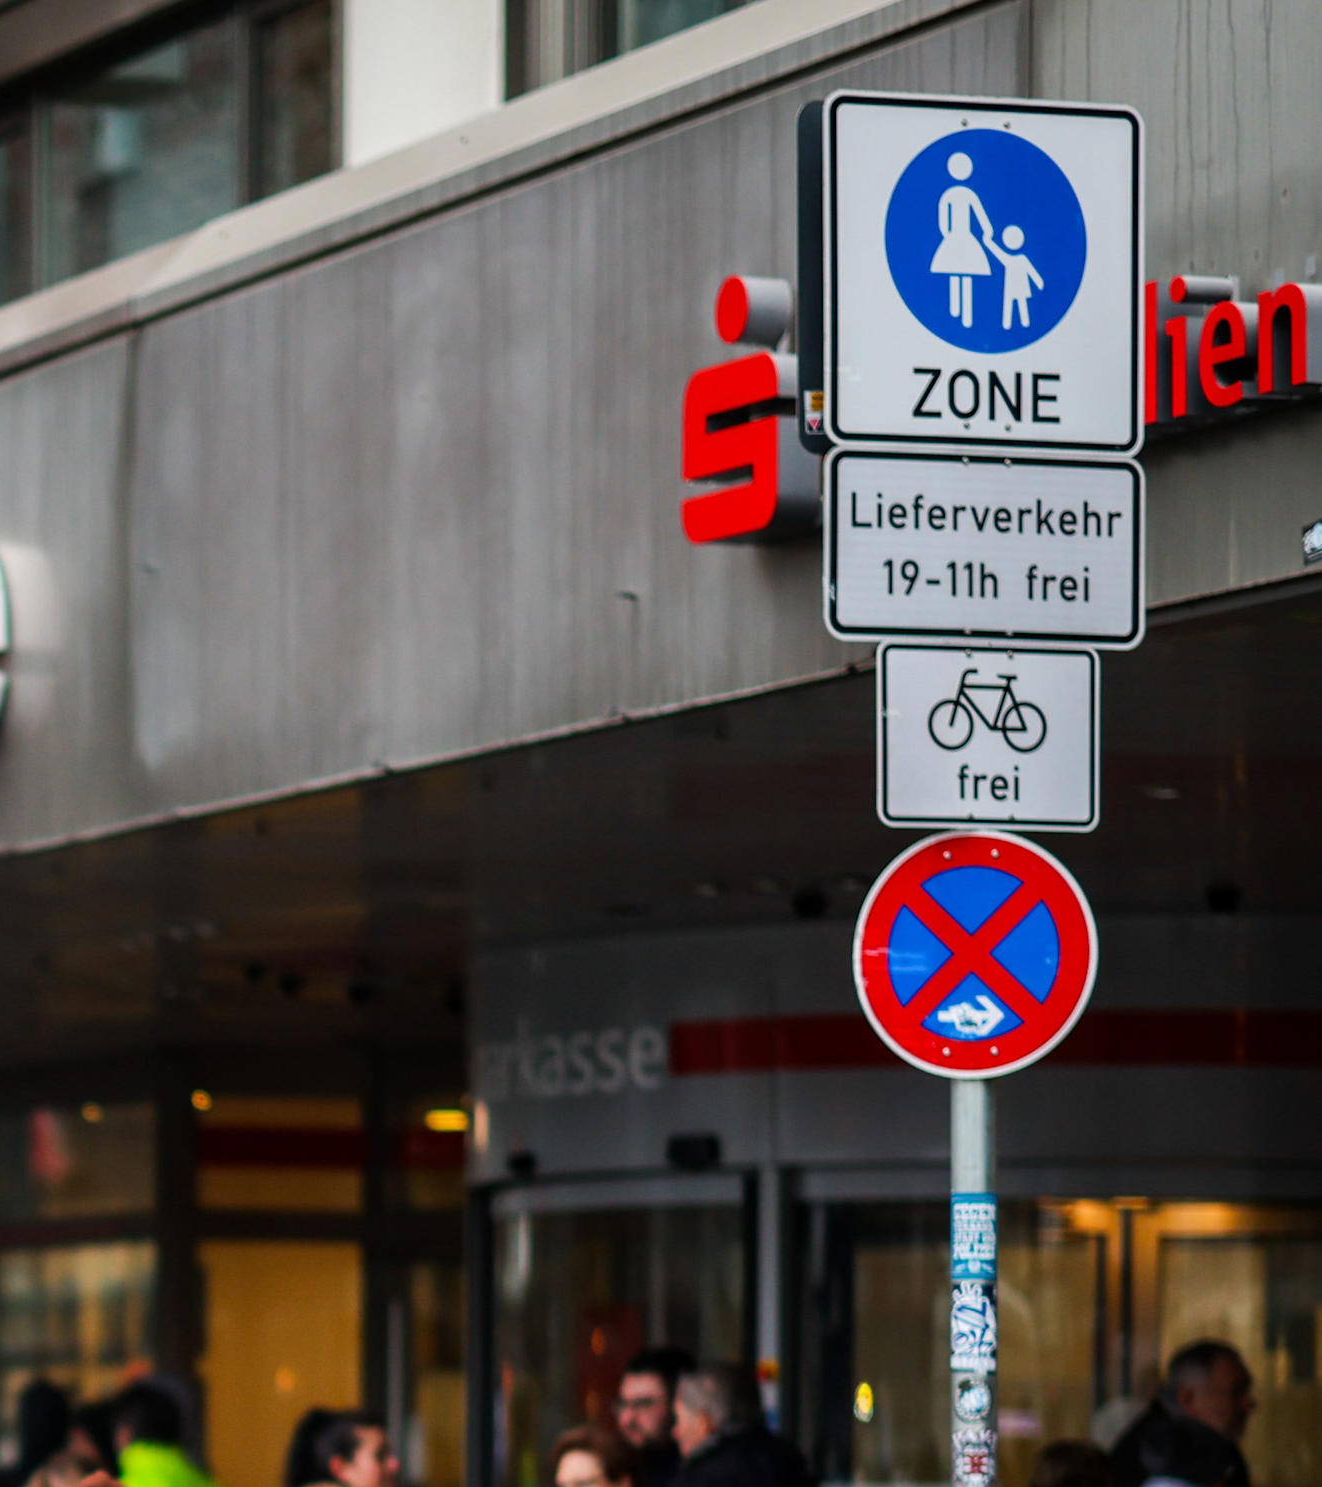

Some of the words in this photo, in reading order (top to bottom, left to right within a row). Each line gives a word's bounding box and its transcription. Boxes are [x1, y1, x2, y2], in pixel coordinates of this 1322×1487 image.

[911, 366, 1062, 424] ZONE
[850, 492, 1123, 538] Lieferverkehr
[882, 559, 999, 599] 19-11h
[1026, 563, 1091, 604] frei
[957, 764, 1021, 802] frei
